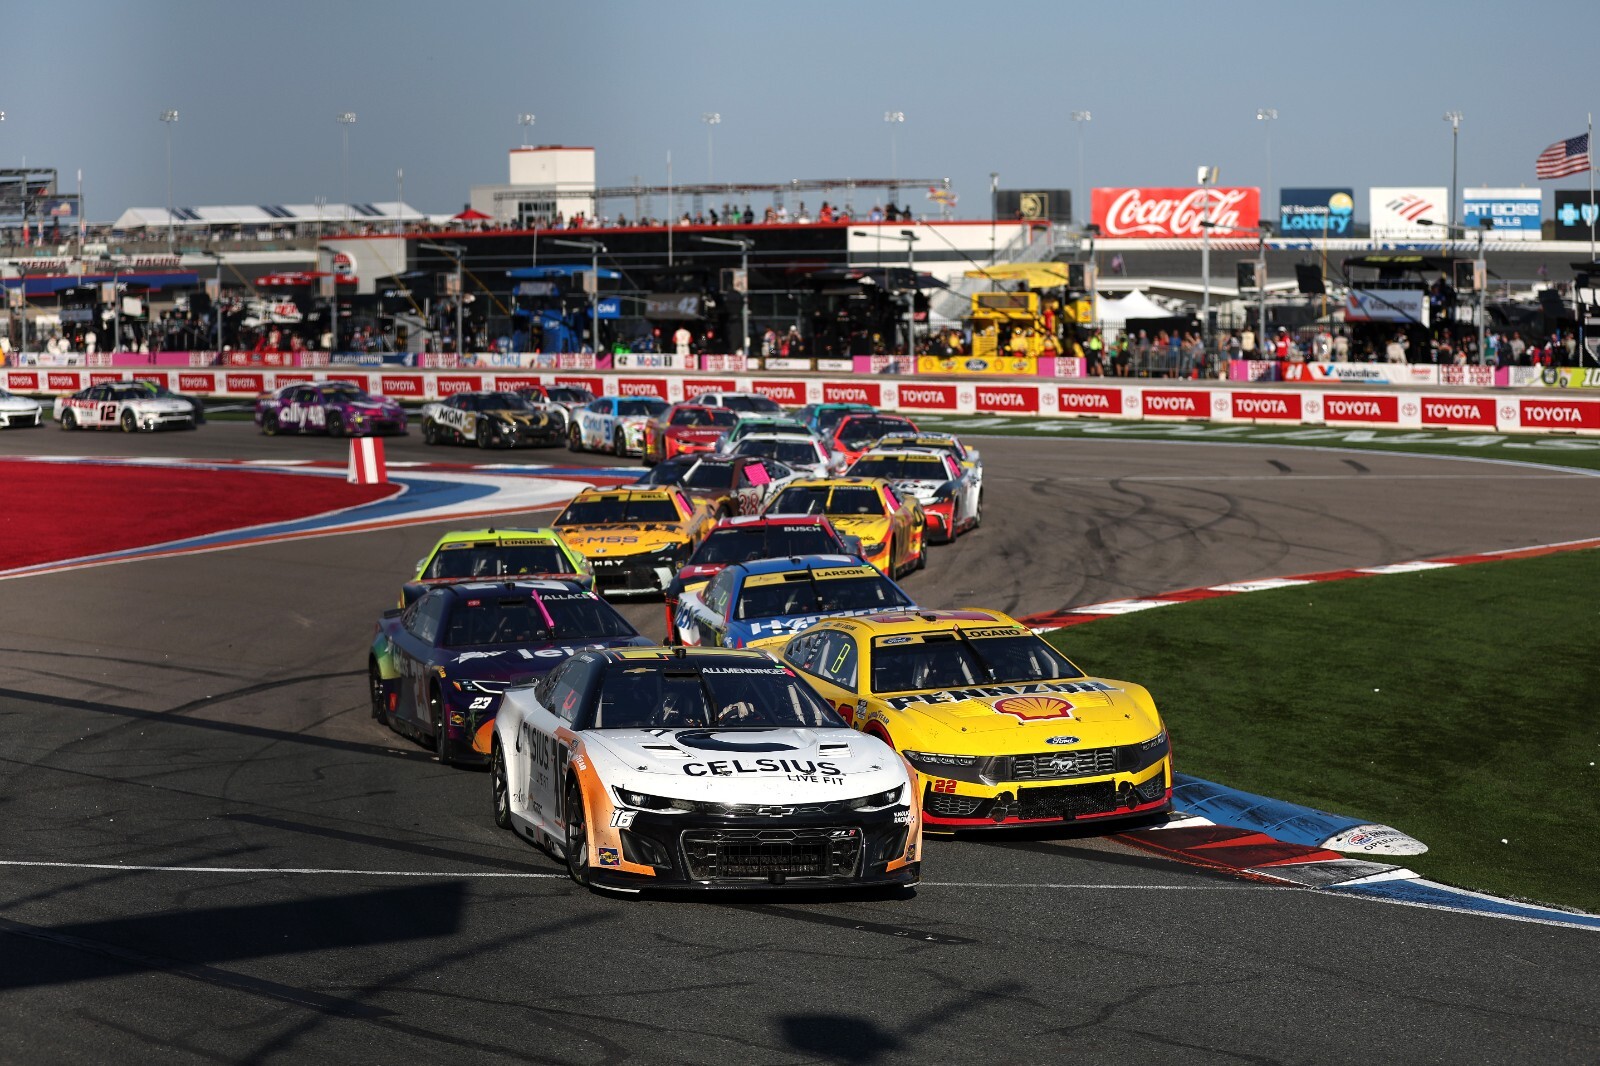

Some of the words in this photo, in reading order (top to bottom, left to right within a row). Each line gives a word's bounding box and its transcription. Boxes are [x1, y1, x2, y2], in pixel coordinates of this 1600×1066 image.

[1105, 188, 1247, 235] Coca-Cola
[1281, 205, 1294, 214] NC
[1295, 205, 1330, 214] Education
[1464, 203, 1490, 216] PIT
[1491, 203, 1540, 216] BOSS
[1281, 214, 1351, 233] Lottery
[1488, 216, 1522, 226] RILLS
[636, 356, 662, 367] Mobil
[1336, 366, 1380, 378] Valvoline
[9, 375, 33, 386] TOYOTA
[49, 375, 74, 387] TOYOTA
[181, 377, 208, 389] TOYOTA
[228, 377, 258, 389] TOYOTA
[384, 380, 416, 392] TOYOTA
[440, 381, 472, 393] TOYOTA
[621, 383, 659, 396] TOYOTA
[756, 387, 796, 399] TOYOTA
[826, 388, 868, 401] TOYOTA
[901, 390, 945, 404] TOYOTA
[980, 392, 1025, 407] TOYOTA
[1061, 393, 1109, 408] TOYOTA
[1146, 396, 1196, 411] TOYOTA
[100, 404, 117, 421] 12
[1235, 398, 1288, 414] TOYOTA
[1327, 400, 1382, 417] TOYOTA
[1425, 403, 1481, 420] TOYOTA
[280, 402, 305, 428] ally
[437, 408, 463, 427] MGM
[463, 411, 476, 433] 3
[1524, 406, 1582, 423] TOYOTA
[738, 489, 760, 515] 38
[586, 535, 639, 544] MSS
[816, 569, 865, 577] LARSON
[532, 593, 590, 602] WALLACE
[886, 637, 907, 645] Ford
[966, 628, 1021, 638] LOGANO
[469, 696, 493, 710] 23
[886, 682, 1120, 711] PENNZOIL
[682, 758, 843, 778] CELSIUS
[787, 774, 819, 783] LIVE
[823, 776, 844, 786] FIT
[934, 779, 958, 794] 22
[609, 809, 637, 829] 16
